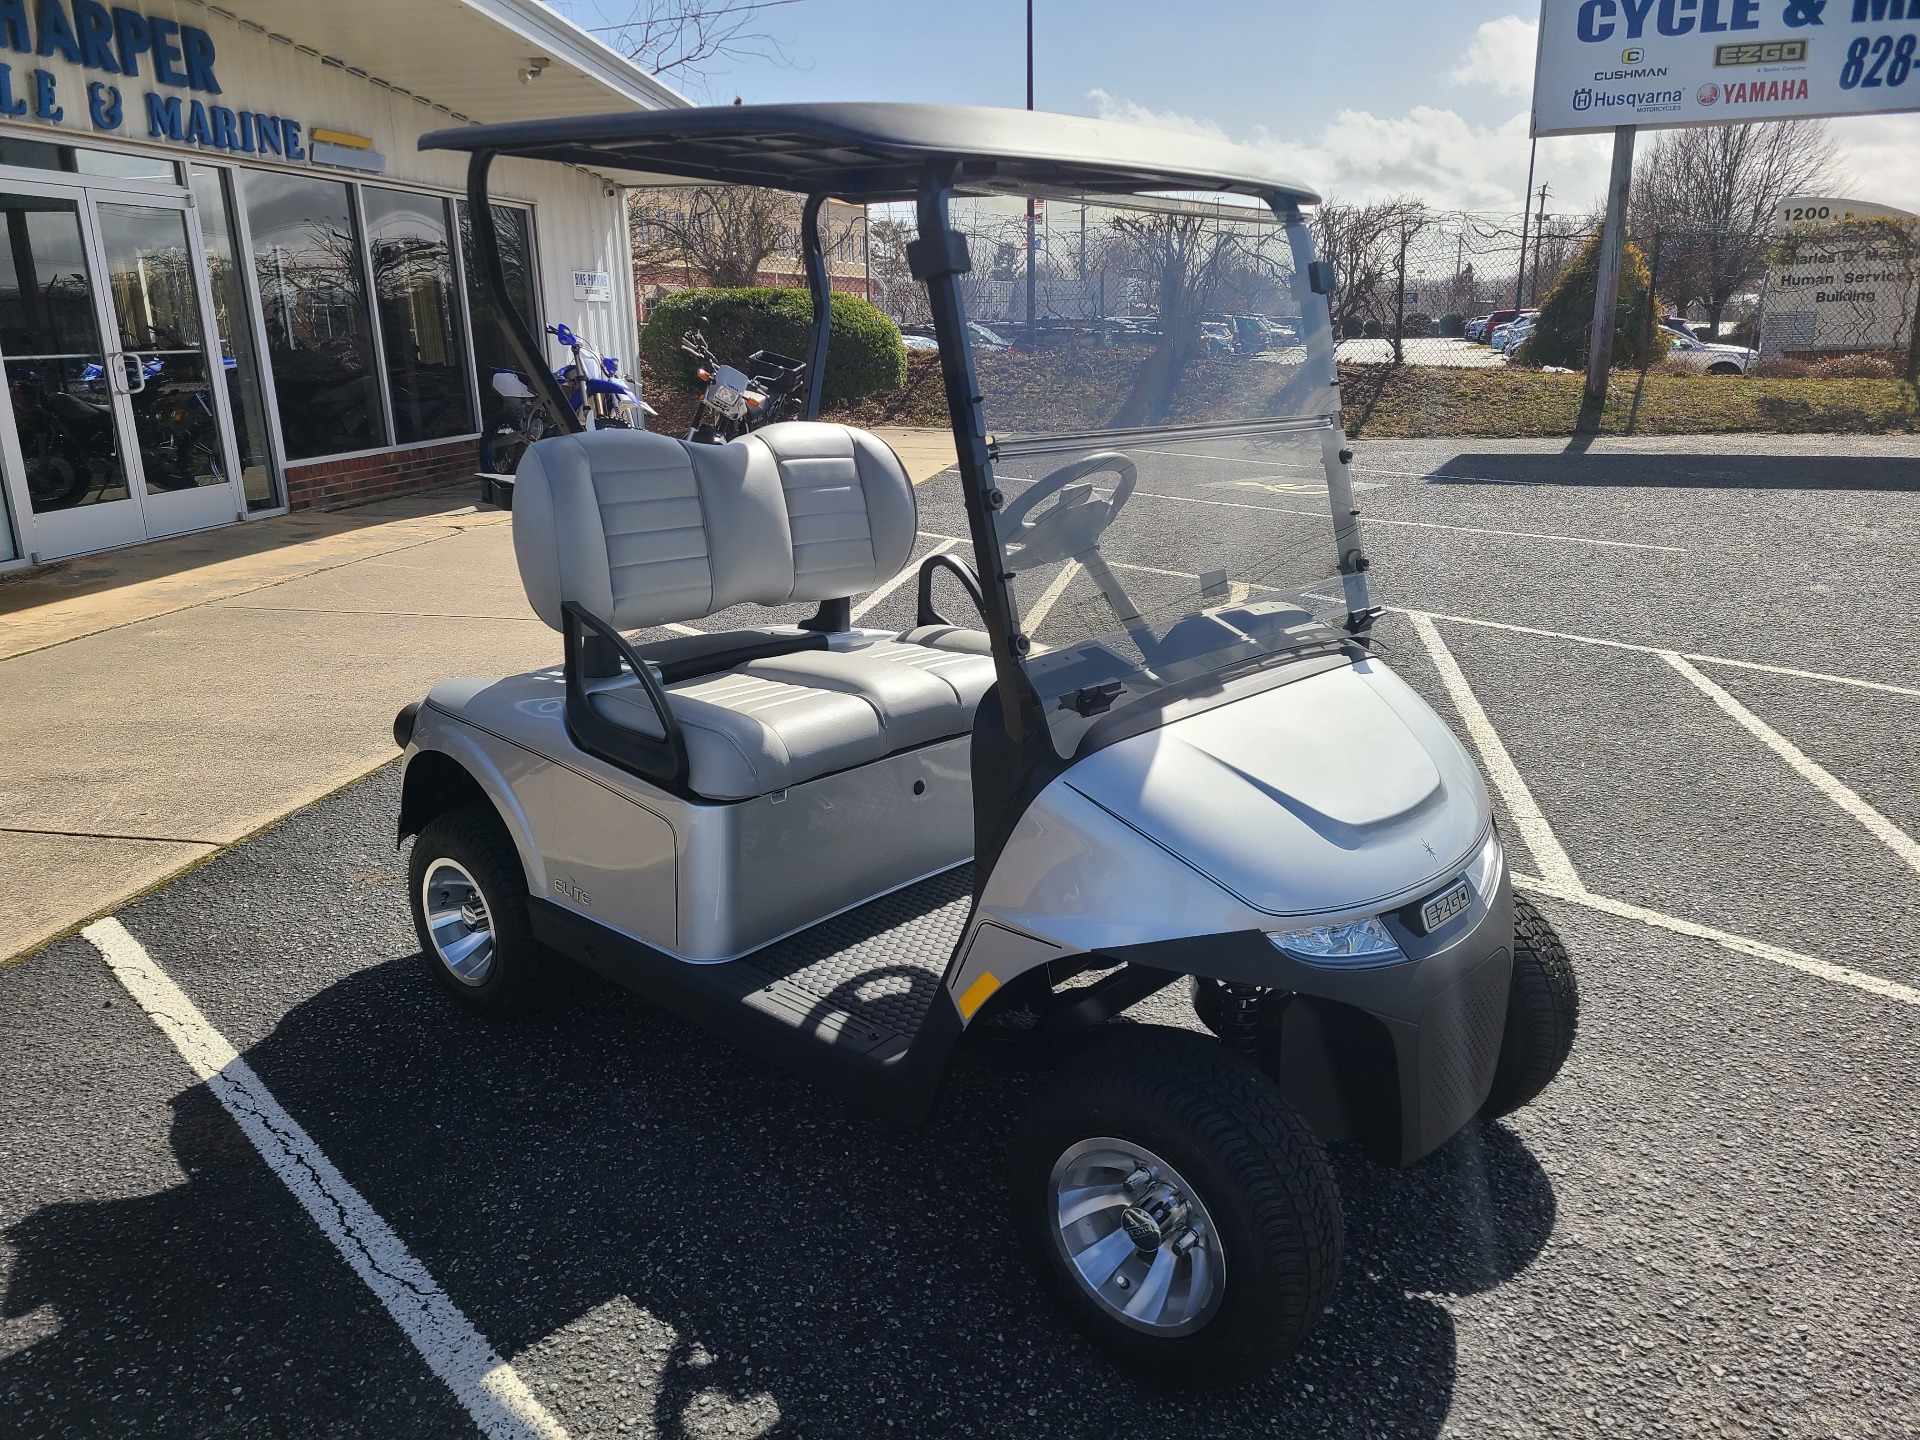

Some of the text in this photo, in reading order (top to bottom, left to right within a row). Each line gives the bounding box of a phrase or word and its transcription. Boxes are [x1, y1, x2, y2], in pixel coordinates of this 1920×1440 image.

[1576, 0, 1759, 43] CYCLE
[1720, 41, 1804, 65] EZGO
[1594, 67, 1668, 81] CUSHMAN
[1594, 90, 1682, 107] Husqvarna
[1723, 79, 1809, 104] YAMAHA
[1636, 105, 1682, 113] MOTORCYCLES
[89, 81, 123, 130] &
[145, 92, 306, 160] MARINE
[1784, 206, 1830, 221] 1200
[1781, 275, 1834, 286] Human
[1815, 291, 1876, 303] Building
[554, 878, 592, 907] ELITE
[1426, 886, 1470, 927] EZGO
